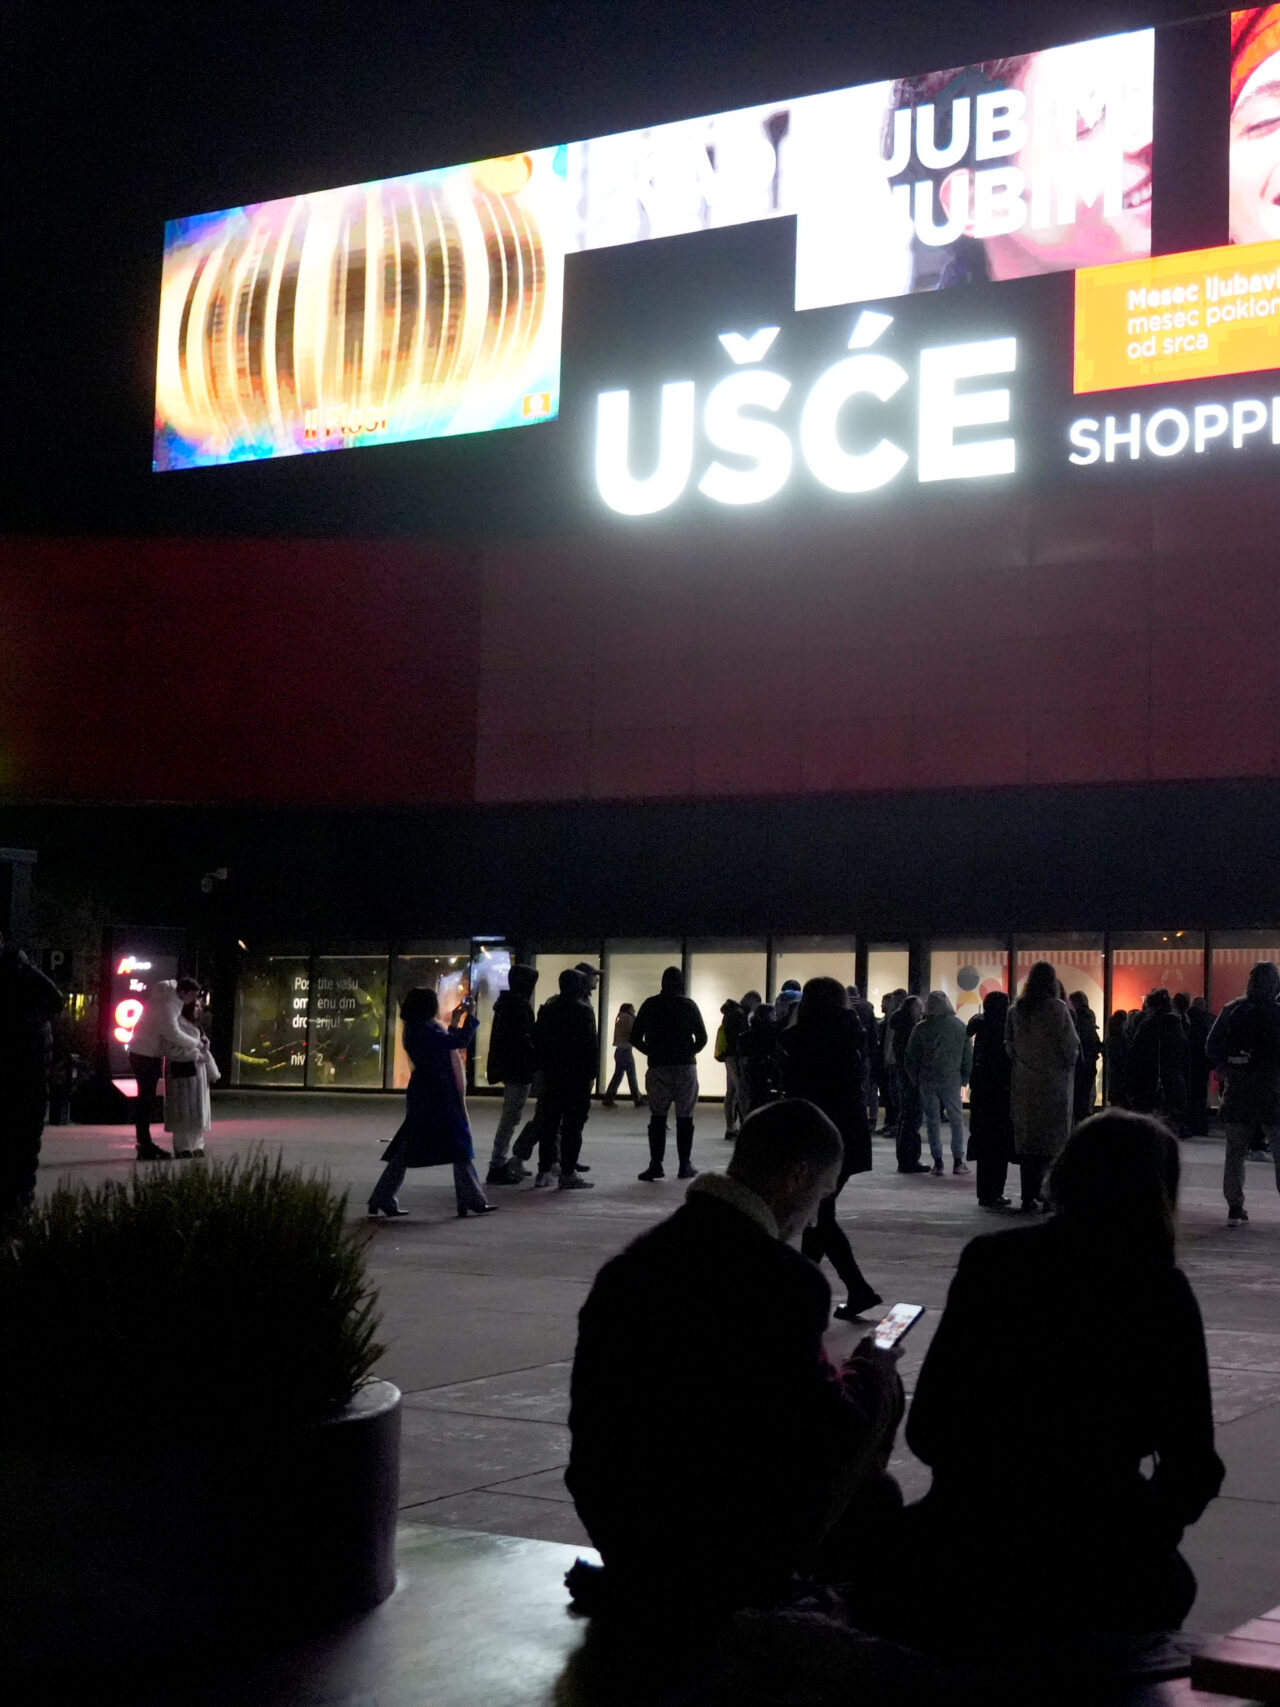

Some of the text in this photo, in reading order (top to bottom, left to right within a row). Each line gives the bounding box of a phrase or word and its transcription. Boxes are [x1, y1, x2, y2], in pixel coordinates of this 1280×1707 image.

[878, 70, 1125, 177] JUBIM
[1127, 284, 1199, 310] Mesec
[1127, 309, 1199, 334] mesec
[1127, 333, 1209, 359] od srca
[594, 311, 1017, 516] UŠĆE
[50, 951, 64, 970] P
